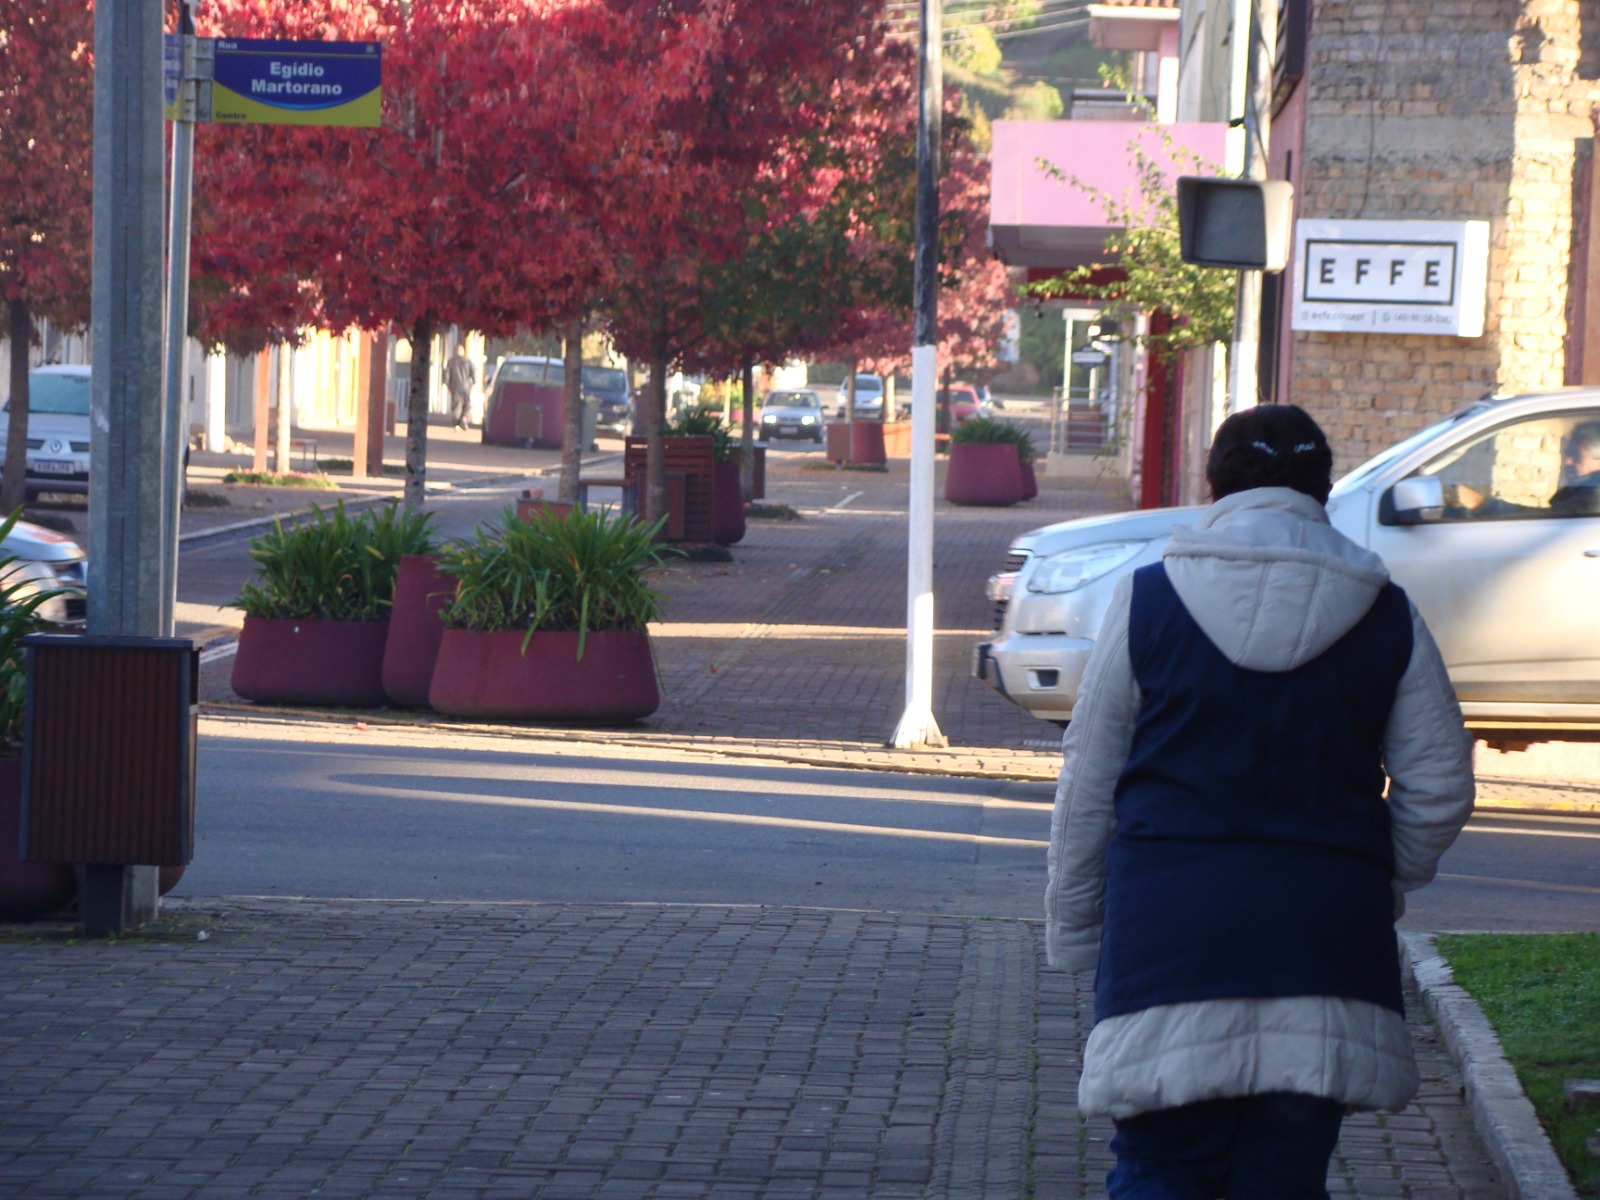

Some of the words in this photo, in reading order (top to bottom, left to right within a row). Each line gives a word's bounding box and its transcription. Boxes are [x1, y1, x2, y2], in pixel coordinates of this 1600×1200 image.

[218, 40, 237, 49] Rua
[270, 61, 325, 79] Egídio
[251, 79, 342, 96] Martorano
[216, 111, 247, 120] Centro
[1320, 258, 1440, 287] EFFE
